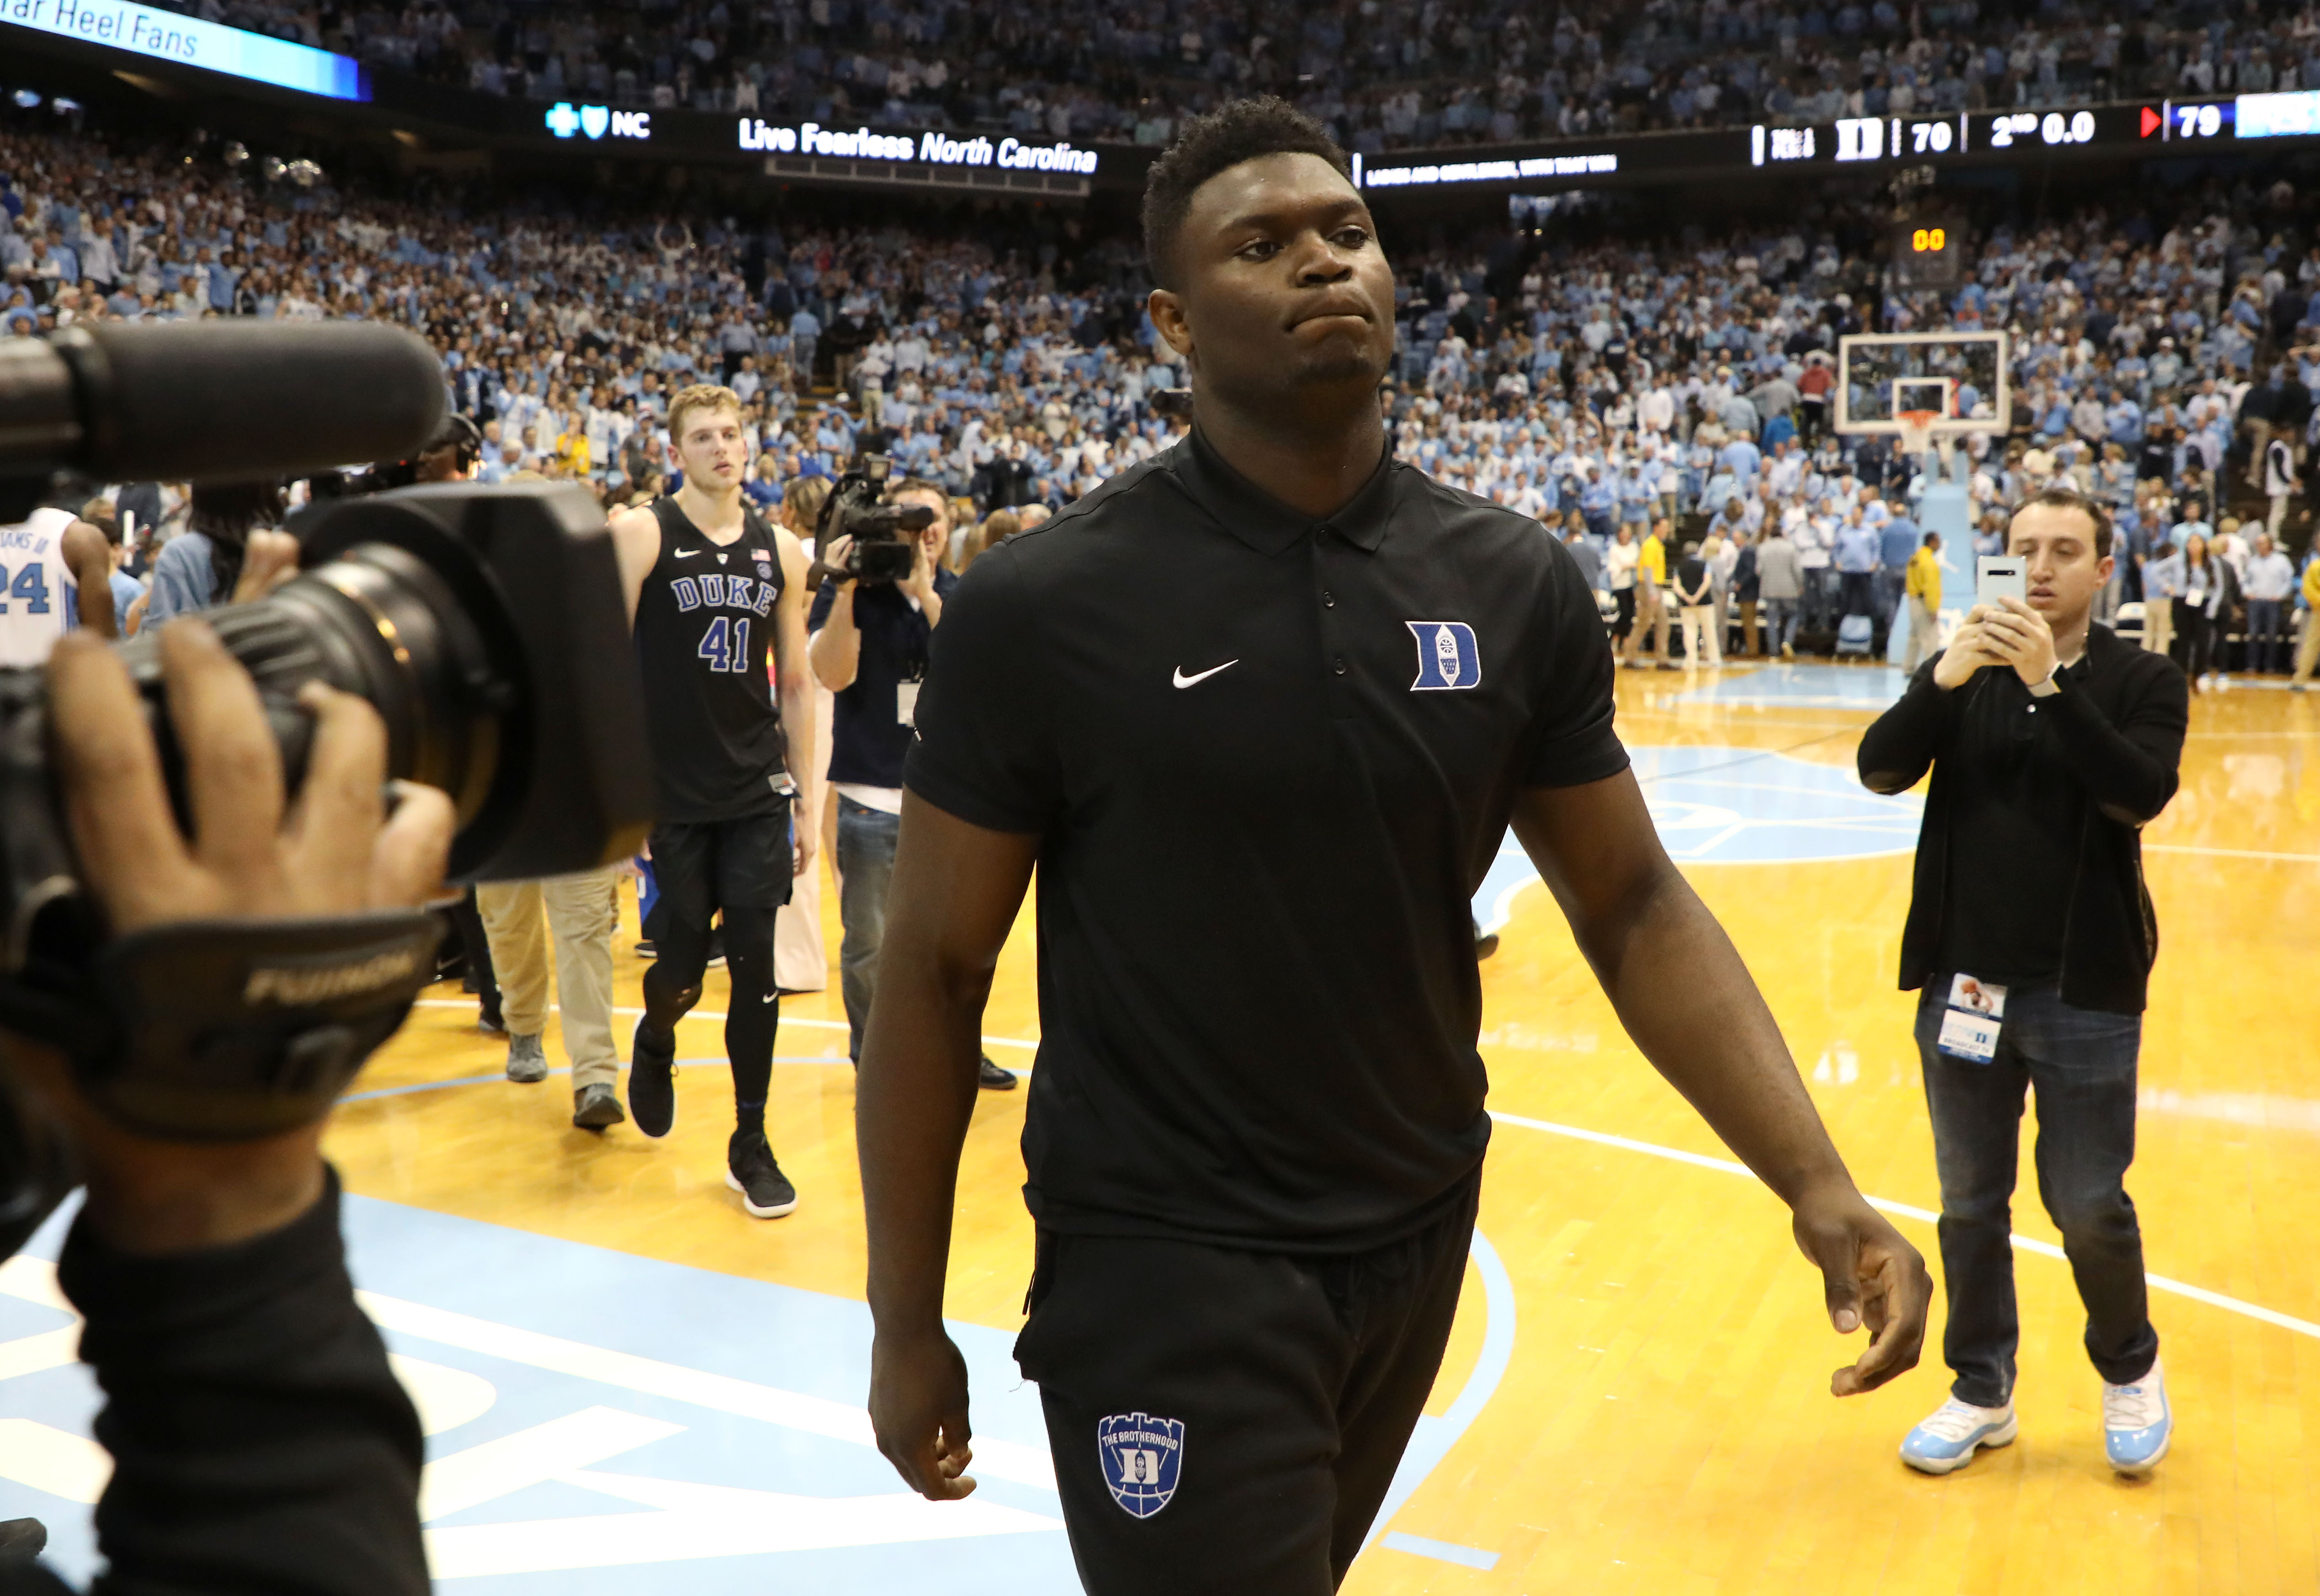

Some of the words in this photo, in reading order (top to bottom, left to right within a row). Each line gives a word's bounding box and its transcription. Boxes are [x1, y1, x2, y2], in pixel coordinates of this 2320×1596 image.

[55, 0, 124, 39] Heel
[131, 14, 197, 58] Fans
[612, 111, 650, 138] NC
[1911, 122, 1952, 152] 70
[1991, 113, 2038, 146] 2ND
[2042, 111, 2095, 144] 0.0
[2177, 105, 2221, 137] 79
[739, 117, 797, 152] Live
[801, 122, 914, 160] Fearless
[919, 132, 993, 165] North
[997, 138, 1098, 173] Carolina
[1913, 228, 1945, 252] 00
[0, 563, 49, 613] 4
[670, 573, 778, 618] DUKE
[698, 616, 751, 673] 41
[1102, 1432, 1118, 1447] THE
[1118, 1431, 1179, 1451] BROTHERHOOD
